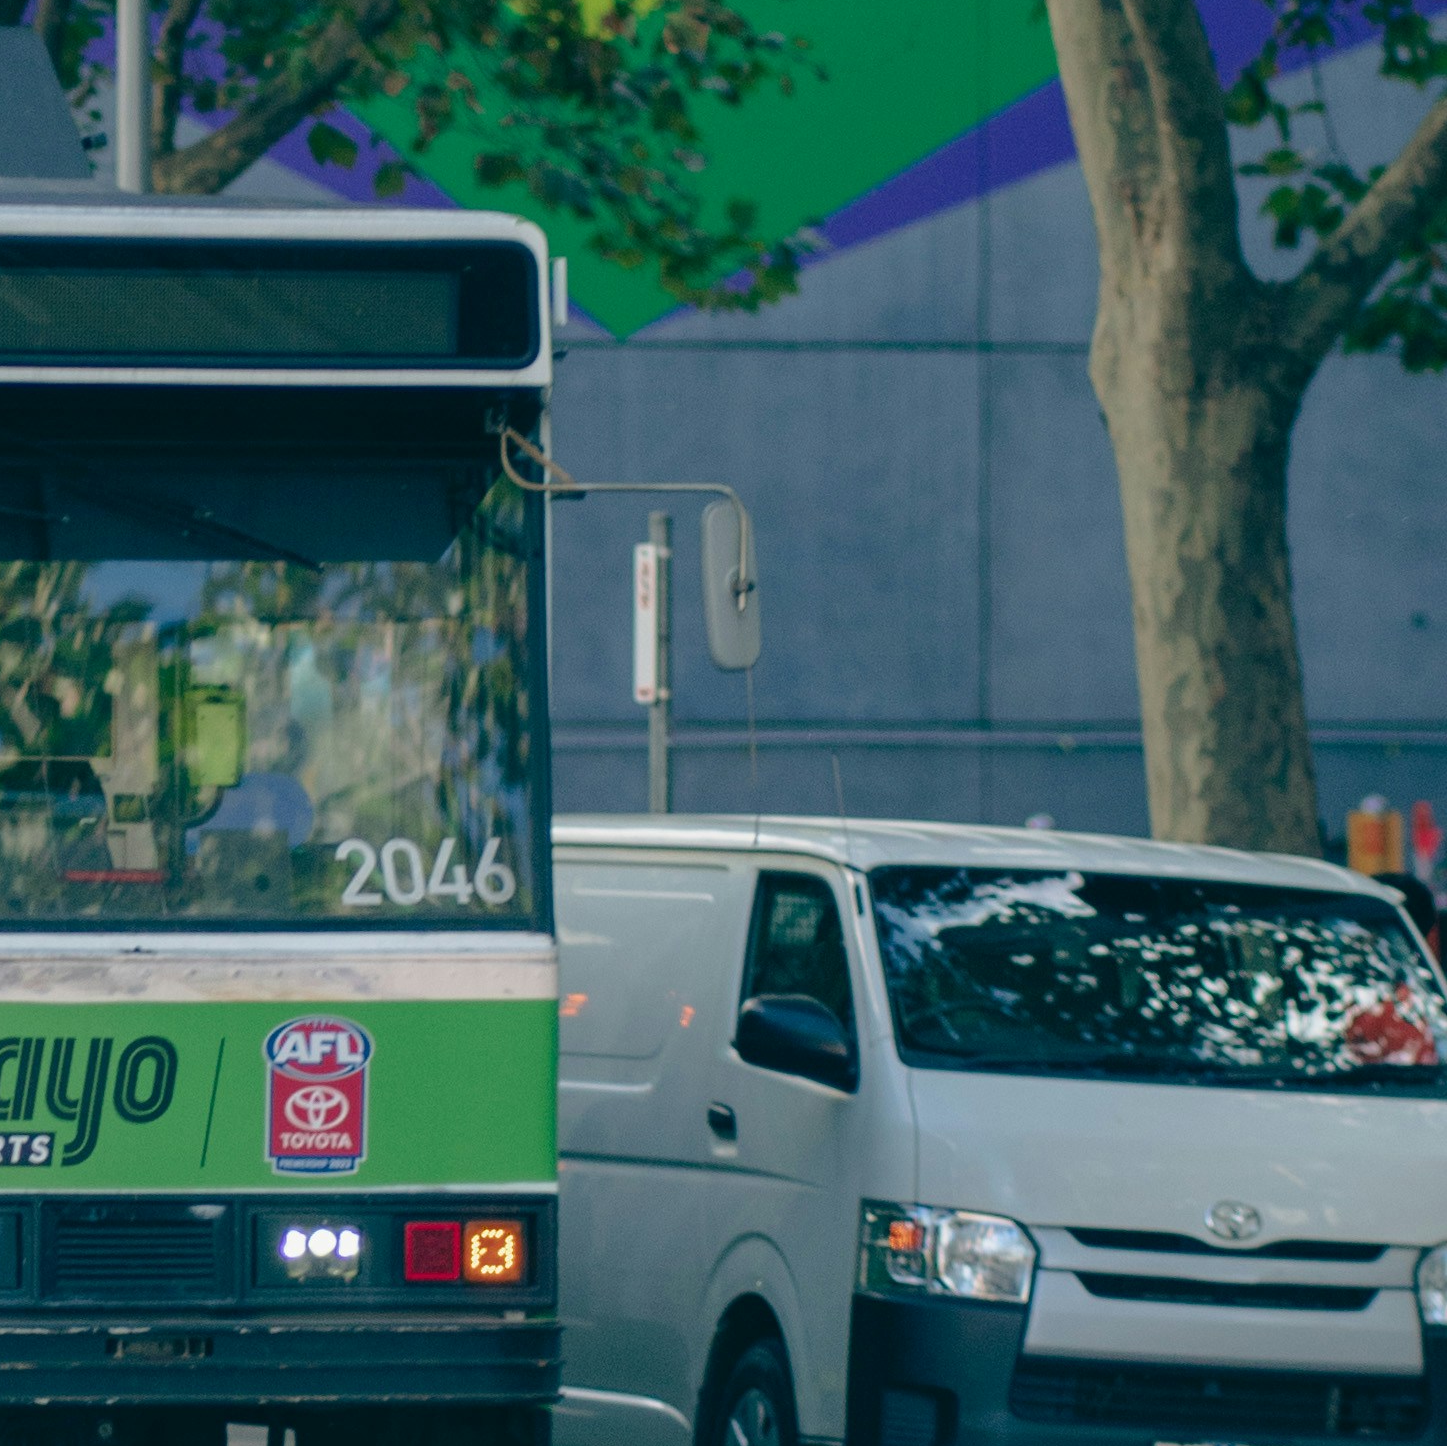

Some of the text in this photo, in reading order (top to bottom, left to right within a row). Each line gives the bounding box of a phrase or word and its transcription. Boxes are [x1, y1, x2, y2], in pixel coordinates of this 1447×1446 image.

[335, 837, 516, 905] 2046
[274, 1031, 363, 1065] AFL
[280, 1132, 353, 1150] TOYOTA
